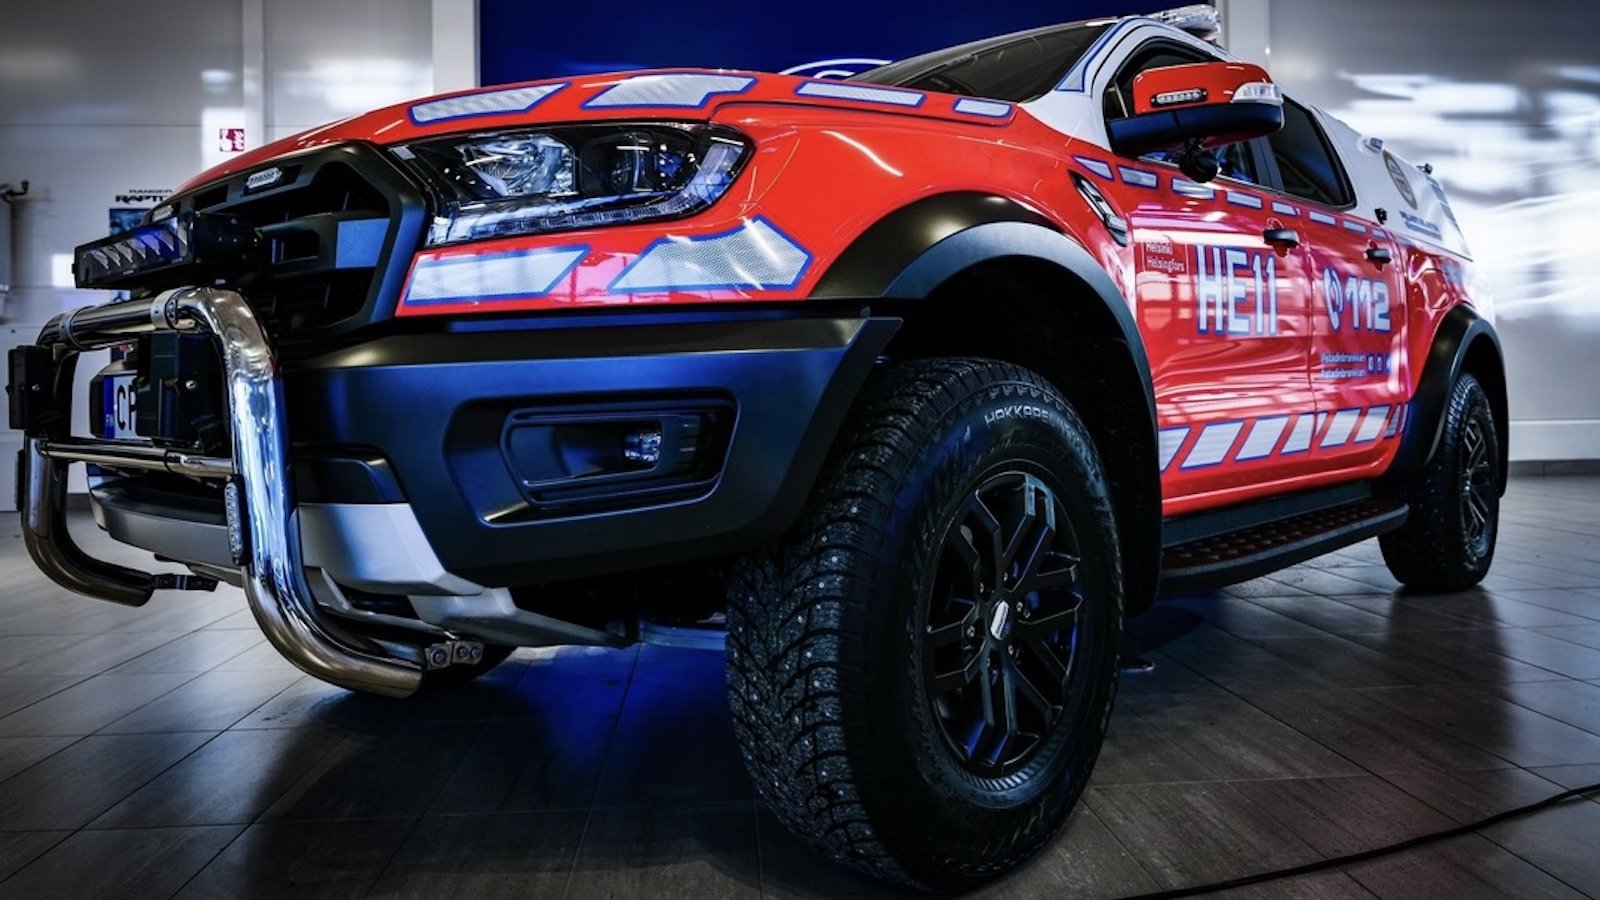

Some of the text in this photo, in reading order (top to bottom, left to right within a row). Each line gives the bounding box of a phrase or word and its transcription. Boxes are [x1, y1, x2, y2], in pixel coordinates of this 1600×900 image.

[115, 196, 169, 205] RAPT
[1197, 244, 1278, 335] HE11
[1344, 277, 1391, 331] 112
